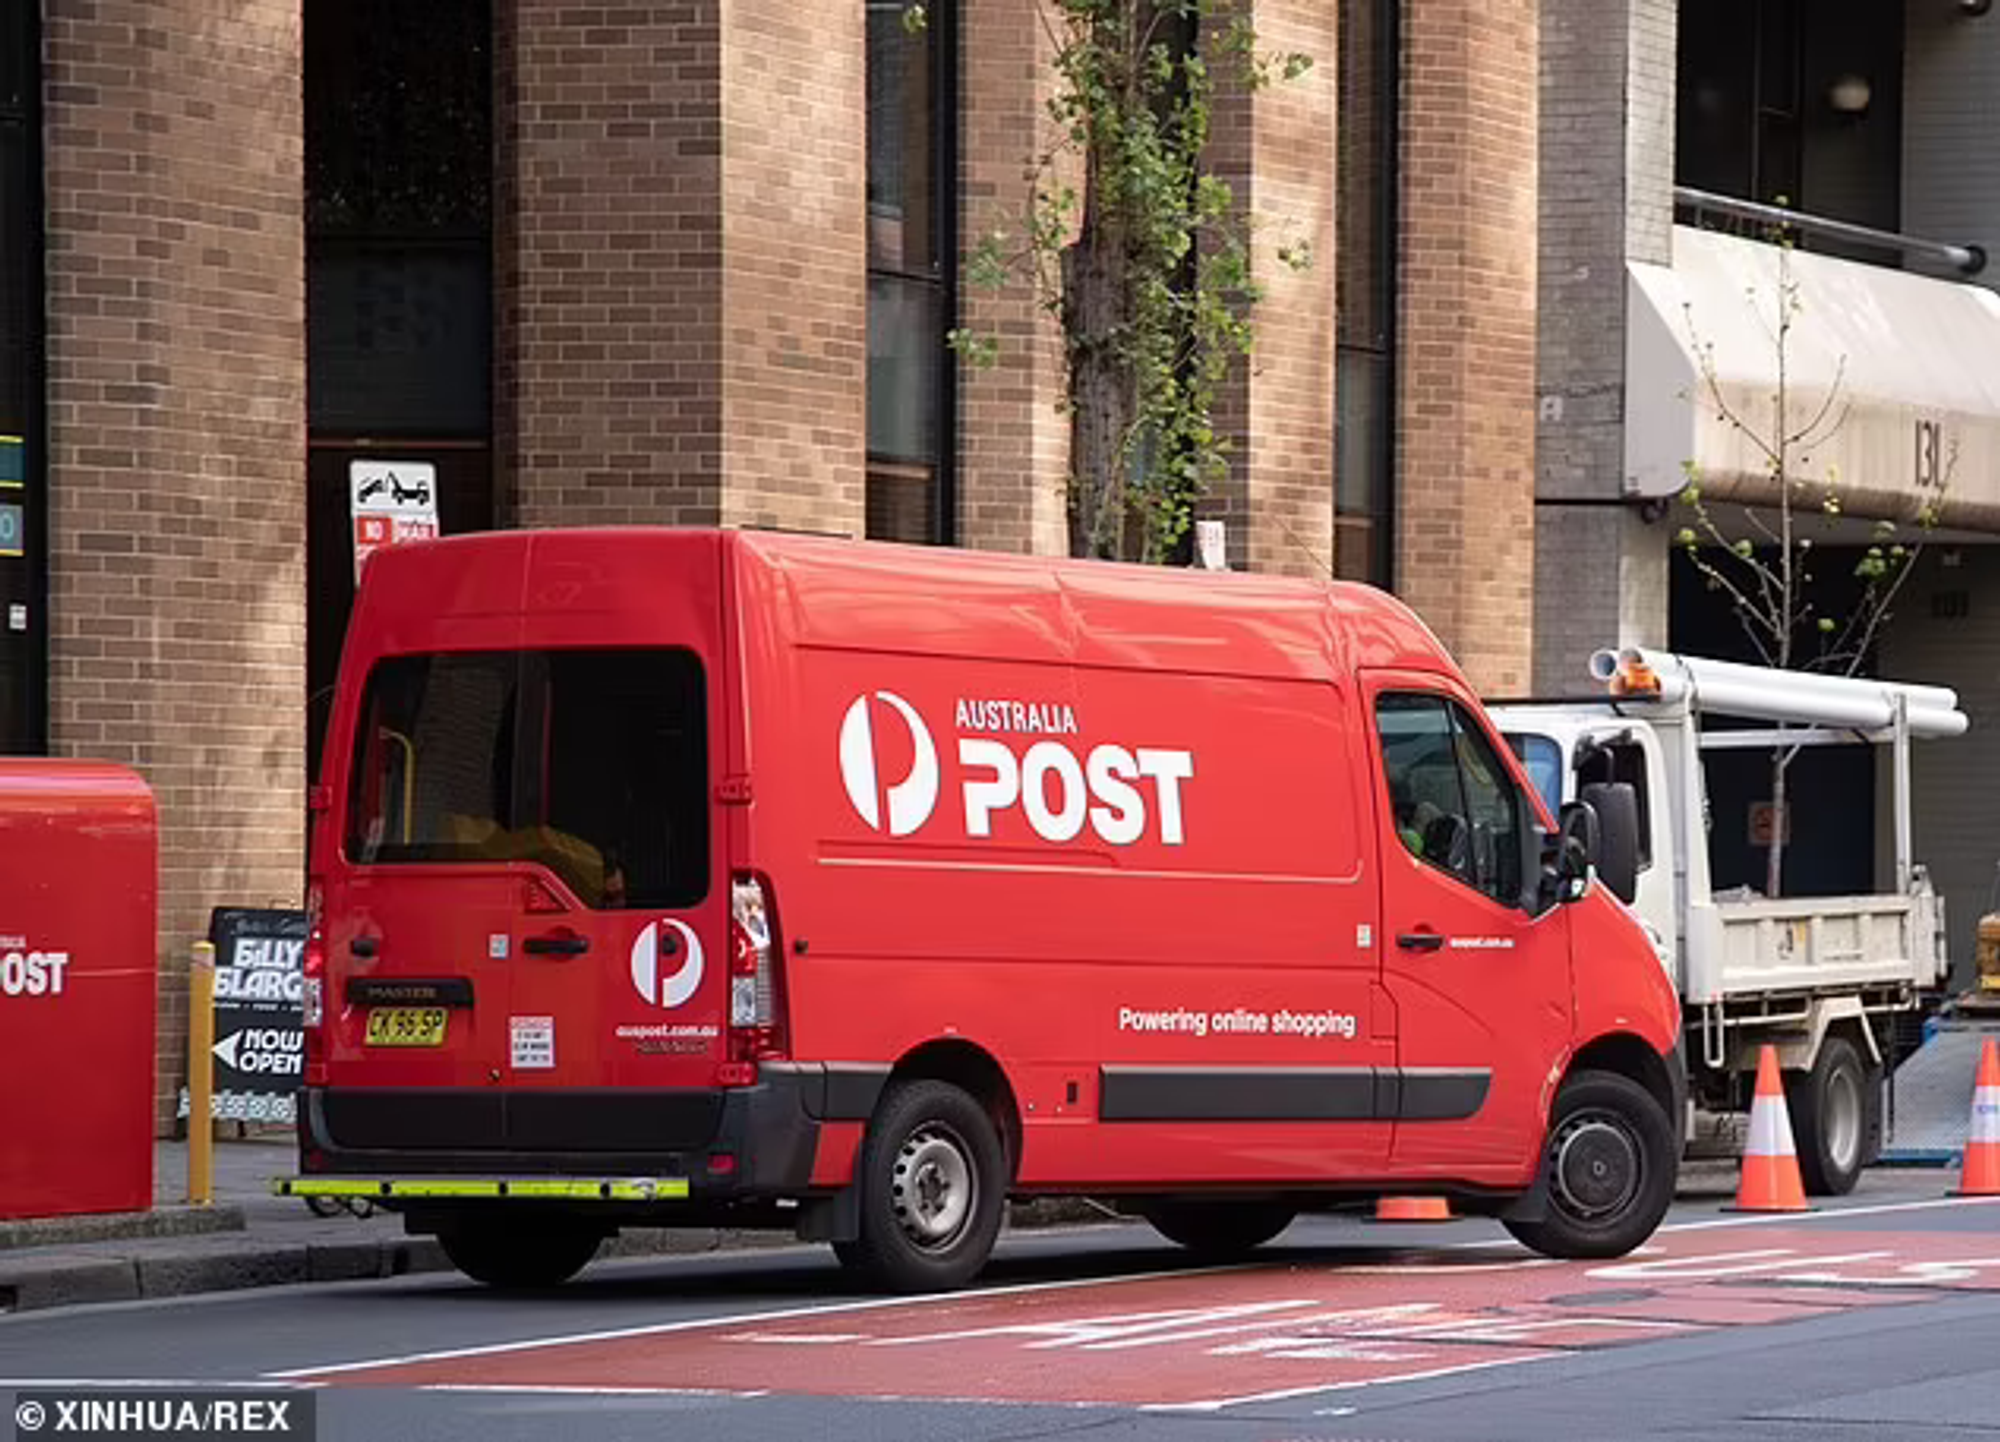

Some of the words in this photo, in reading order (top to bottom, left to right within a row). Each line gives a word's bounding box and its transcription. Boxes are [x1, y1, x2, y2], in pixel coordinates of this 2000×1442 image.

[955, 698, 1078, 734] AUSTRALIA
[958, 738, 1194, 846] POST
[0, 952, 69, 995] OST
[1119, 1007, 1207, 1035] Powering
[1212, 1008, 1269, 1033] online
[1272, 1010, 1357, 1038] shopping
[243, 1028, 304, 1052] NOW
[239, 1051, 303, 1075] OPEN
